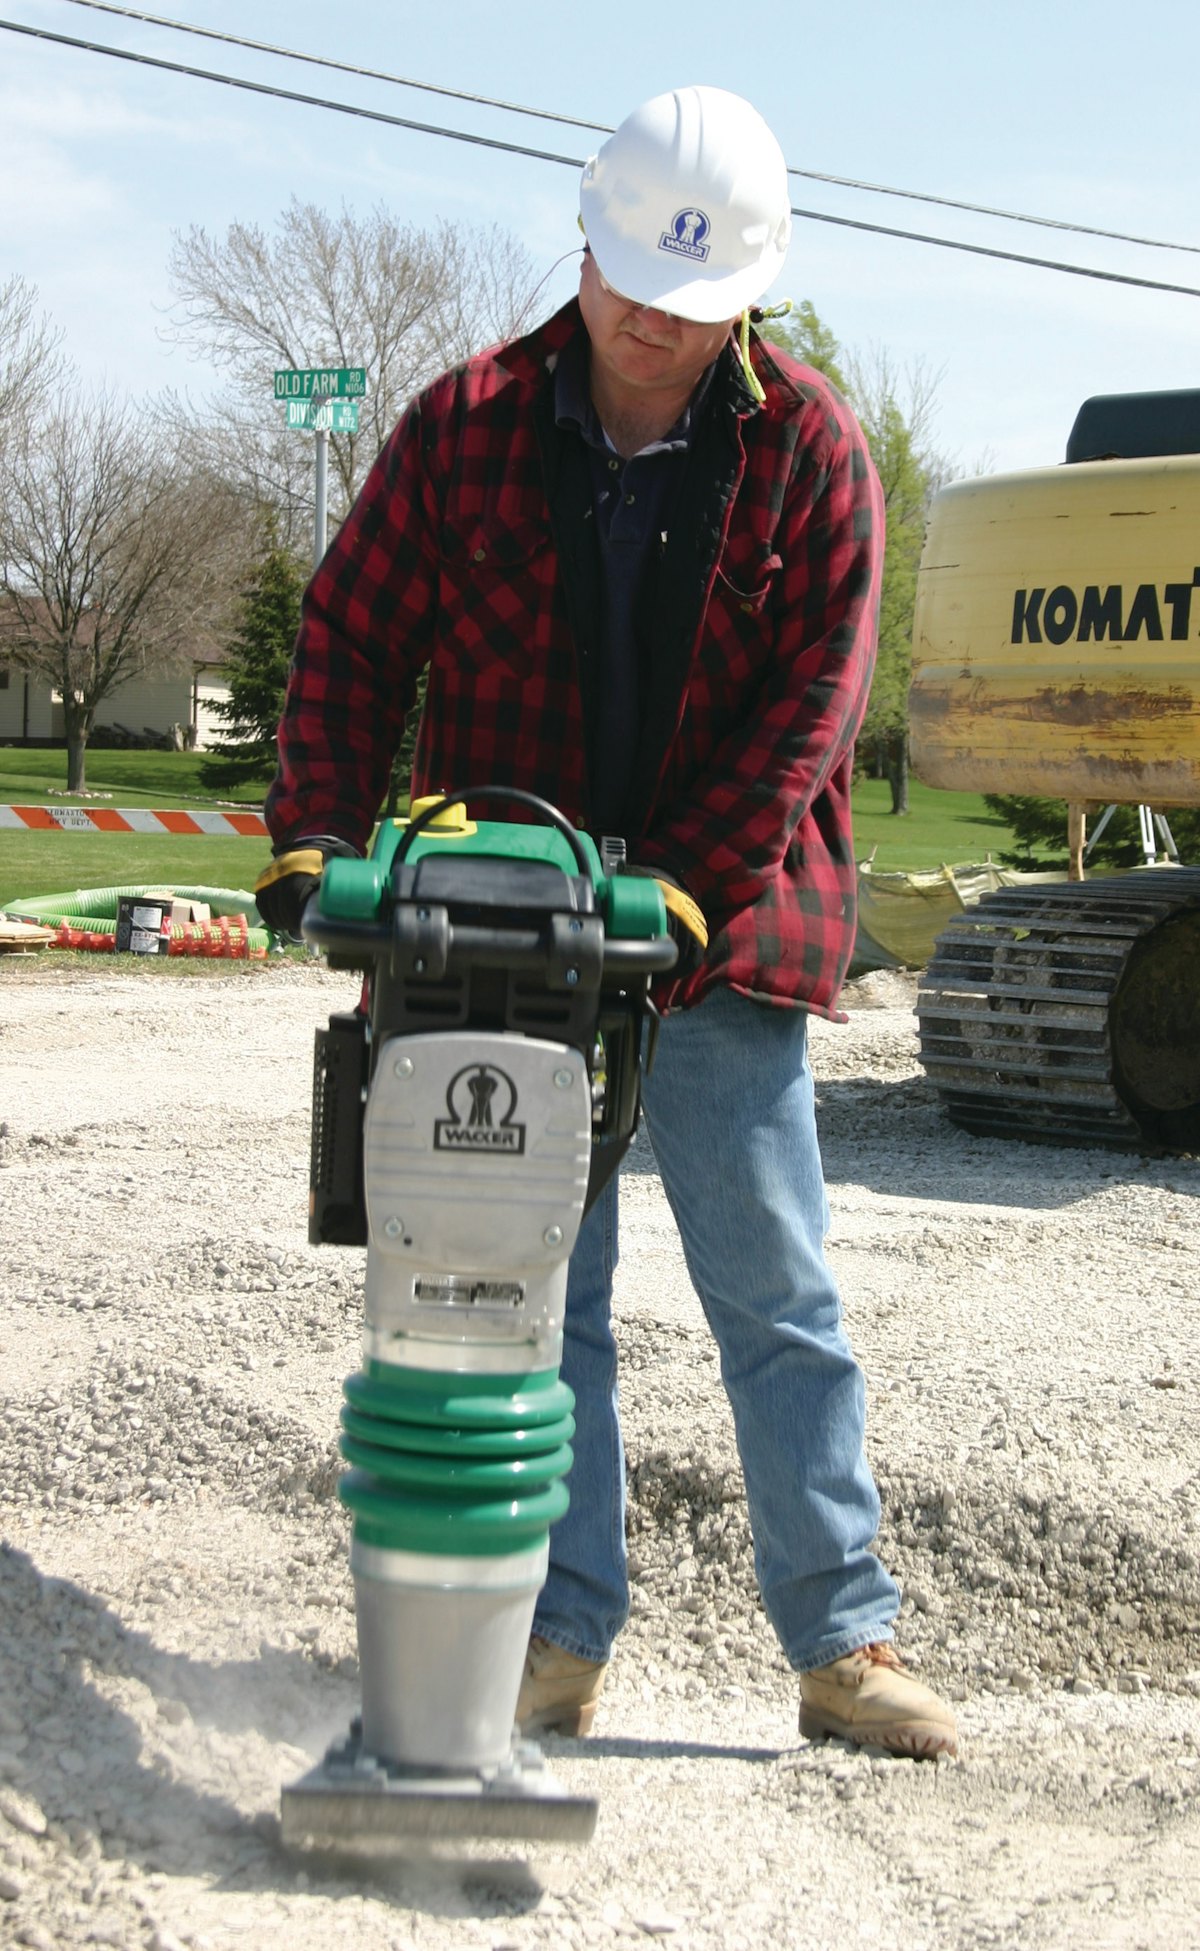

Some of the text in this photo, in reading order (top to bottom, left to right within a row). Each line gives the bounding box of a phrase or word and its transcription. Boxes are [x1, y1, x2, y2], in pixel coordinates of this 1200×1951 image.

[665, 237, 703, 256] WACKER
[276, 372, 361, 395] OLD FARM RD
[345, 383, 364, 393] N106
[289, 402, 352, 426] DIVISION RD
[1011, 567, 1200, 645] KOMAT
[445, 1128, 514, 1145] WACKER
